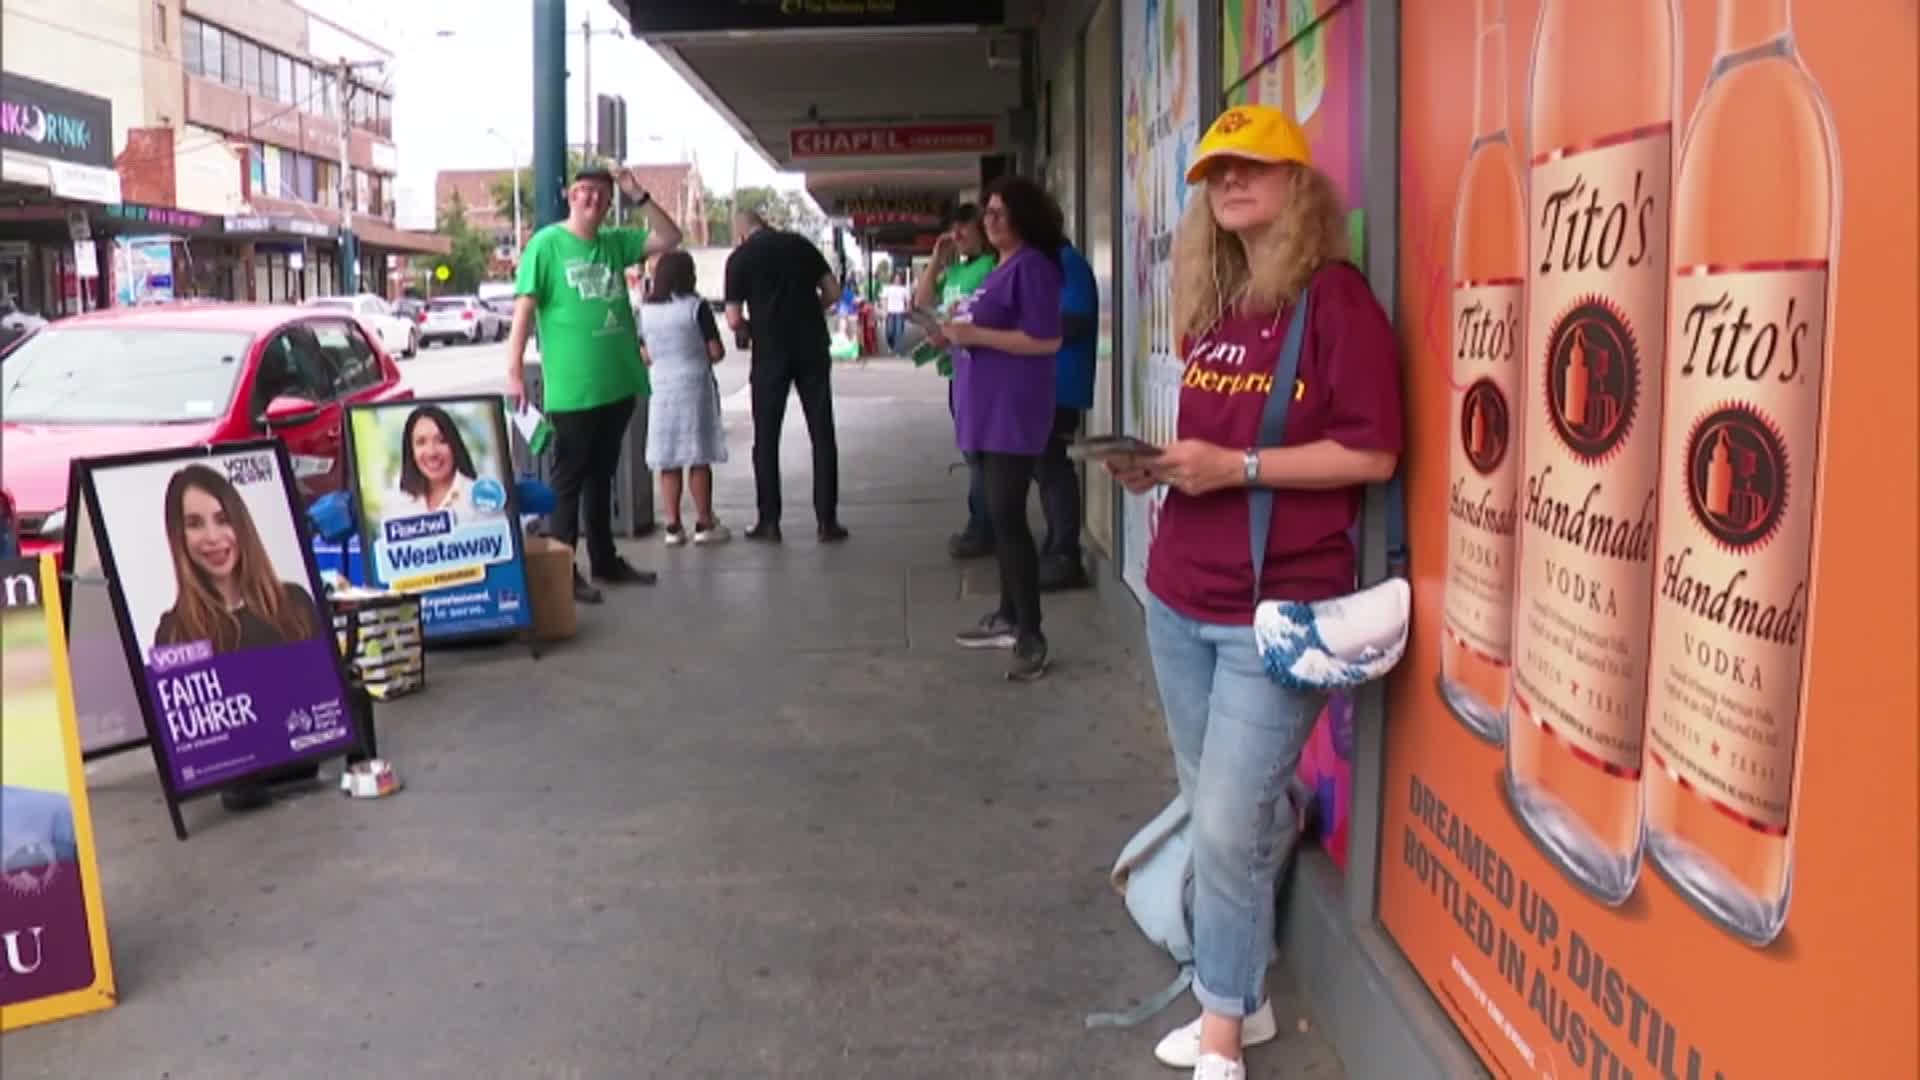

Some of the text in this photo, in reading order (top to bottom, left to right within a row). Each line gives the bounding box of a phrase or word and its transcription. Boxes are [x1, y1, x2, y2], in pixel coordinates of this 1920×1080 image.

[797, 130, 901, 151] CHAPEL
[1540, 171, 1655, 275] Tito's
[1458, 299, 1518, 361] Tito's
[1681, 291, 1809, 383] Tito's
[390, 517, 447, 541] Rachel
[1524, 465, 1655, 564] Handmade
[387, 535, 504, 570] Westaway
[1544, 559, 1619, 618] VODKA
[1661, 547, 1803, 646] Handmade
[157, 667, 223, 711] FAITH
[1683, 630, 1764, 692] VODKA
[167, 692, 258, 744] FUHRER
[1402, 823, 1495, 958] BOTTLED
[1499, 926, 1526, 997] IN
[1409, 774, 1516, 910] DREAMED
[1518, 879, 1562, 971] UP,
[1567, 929, 1725, 1080] DISTILL
